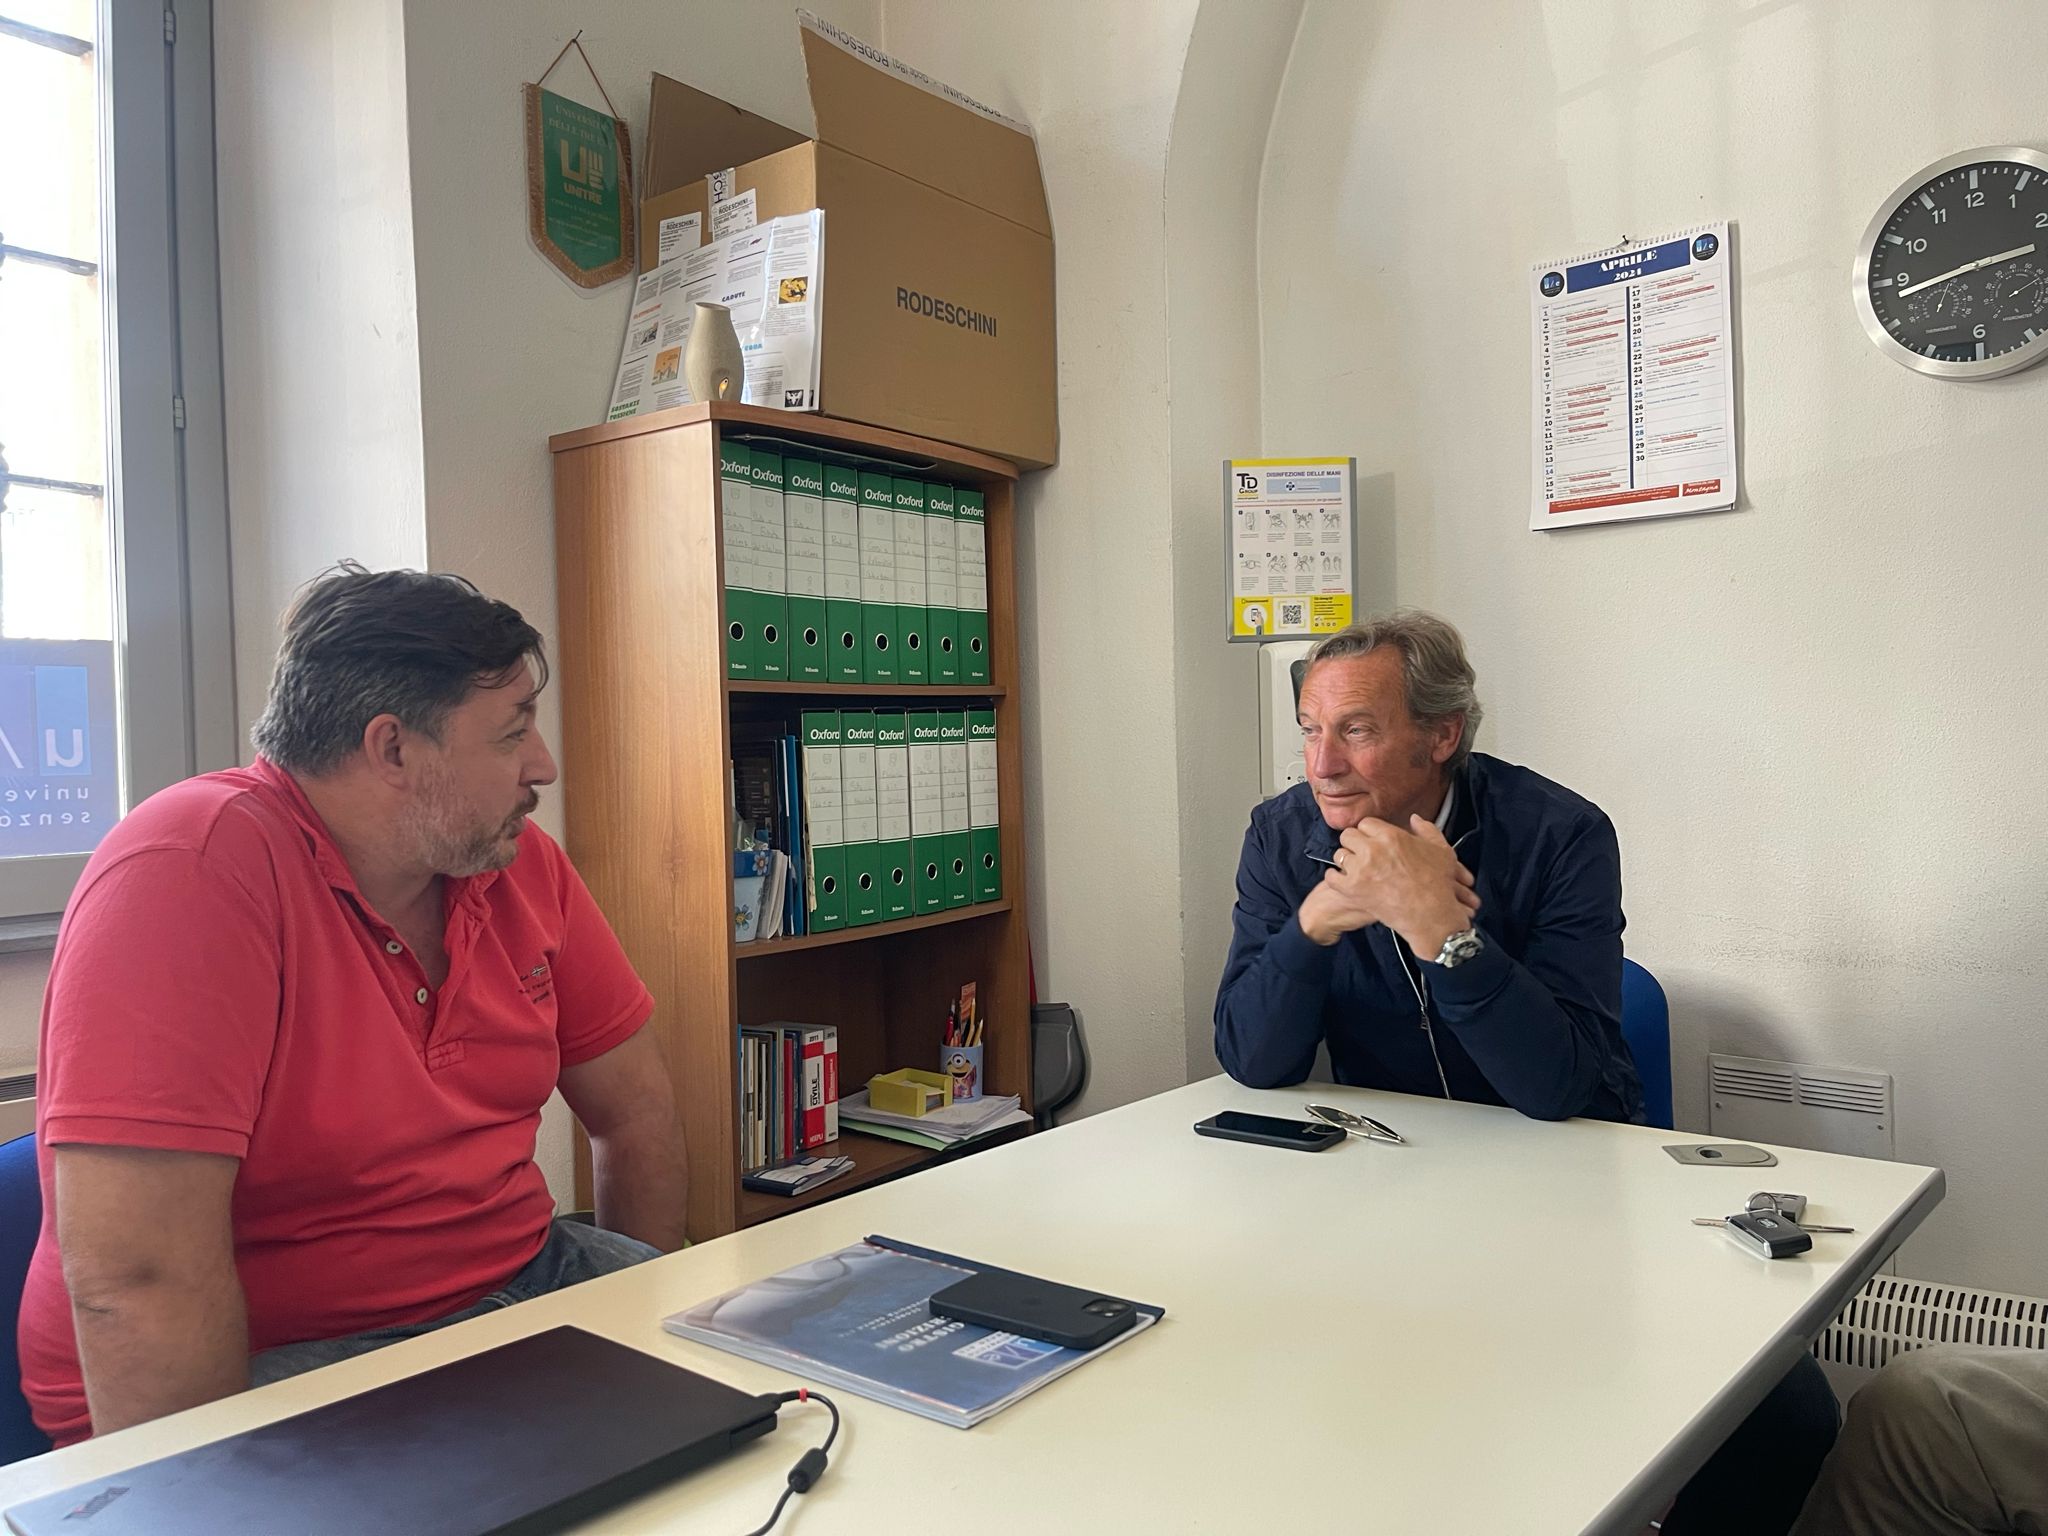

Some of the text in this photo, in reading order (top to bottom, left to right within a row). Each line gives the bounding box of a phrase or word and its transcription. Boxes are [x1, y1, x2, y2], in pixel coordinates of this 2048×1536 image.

[816, 16, 890, 68] RODESCHINI
[563, 182, 603, 205] UNITRE
[1964, 192, 1985, 208] 12
[2009, 194, 2016, 208] 1
[1932, 208, 1947, 225] 11
[2035, 213, 2048, 229] 2
[1905, 238, 1928, 255] 10
[1600, 249, 1657, 272] APRILE
[1897, 272, 1910, 287] 9
[721, 291, 746, 302] CADUTE
[897, 285, 997, 337] RODESCHINI
[1973, 324, 1986, 339] 6
[1635, 429, 1644, 437] 28
[752, 468, 783, 484] Oxford
[792, 475, 822, 491] Oxford
[1236, 473, 1258, 489] TD
[830, 482, 857, 496] Oxford
[865, 489, 892, 503] Oxford
[896, 494, 924, 508] Oxford
[930, 499, 953, 512] Oxford
[960, 505, 984, 517] Oxford
[810, 729, 840, 740] Oxford
[847, 728, 874, 739] Oxford
[878, 730, 905, 740] Oxford
[914, 727, 938, 738] Oxford
[941, 727, 964, 737] Oxford
[972, 724, 995, 734] Oxford
[897, 1321, 966, 1352] GISTRO
